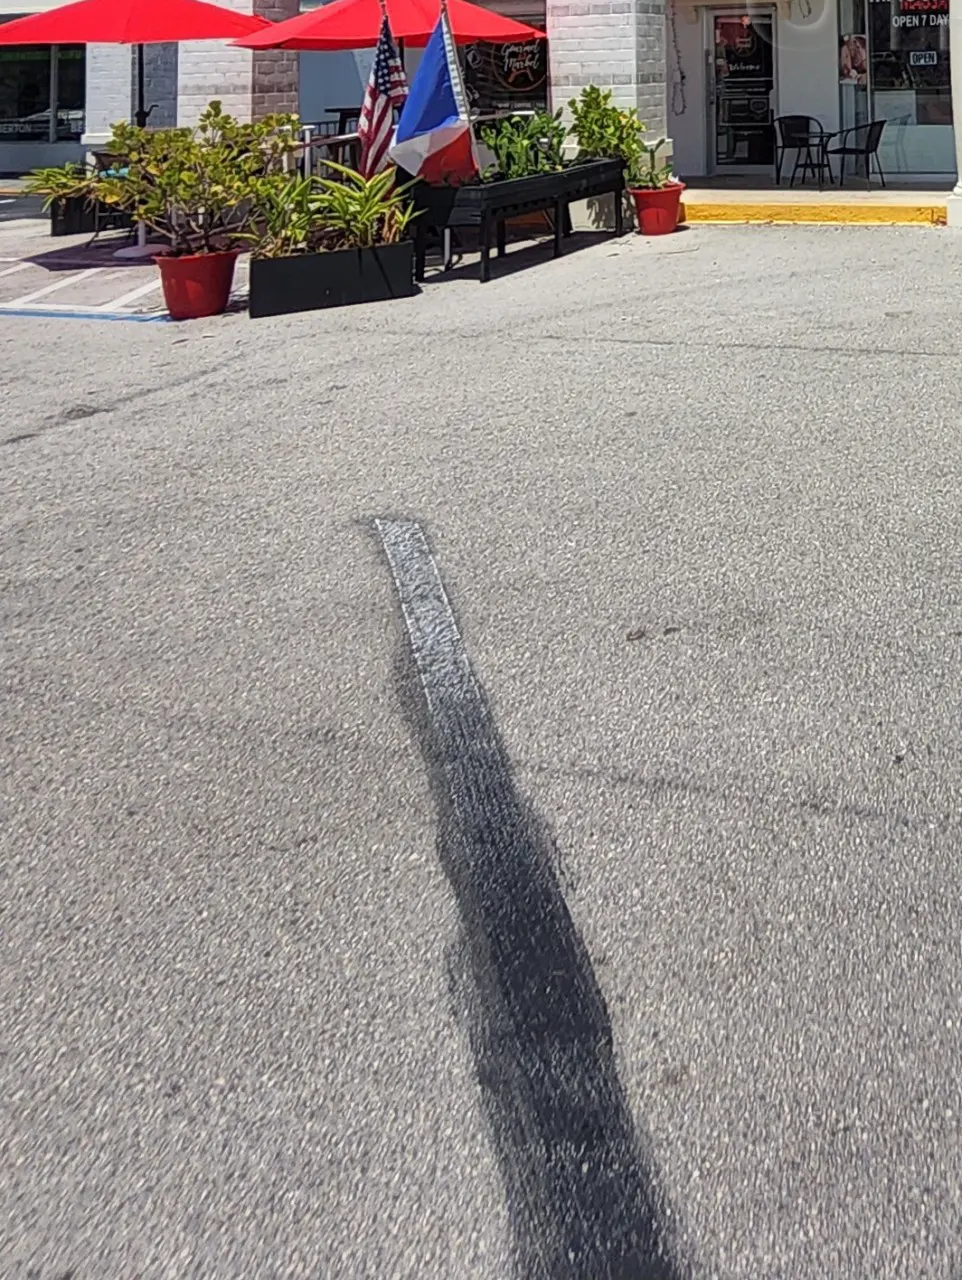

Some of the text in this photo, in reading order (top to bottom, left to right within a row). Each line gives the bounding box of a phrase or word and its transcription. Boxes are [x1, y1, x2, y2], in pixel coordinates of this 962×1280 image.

[892, 13, 950, 28] OPEN 7 DAY
[911, 51, 935, 65] OPEN
